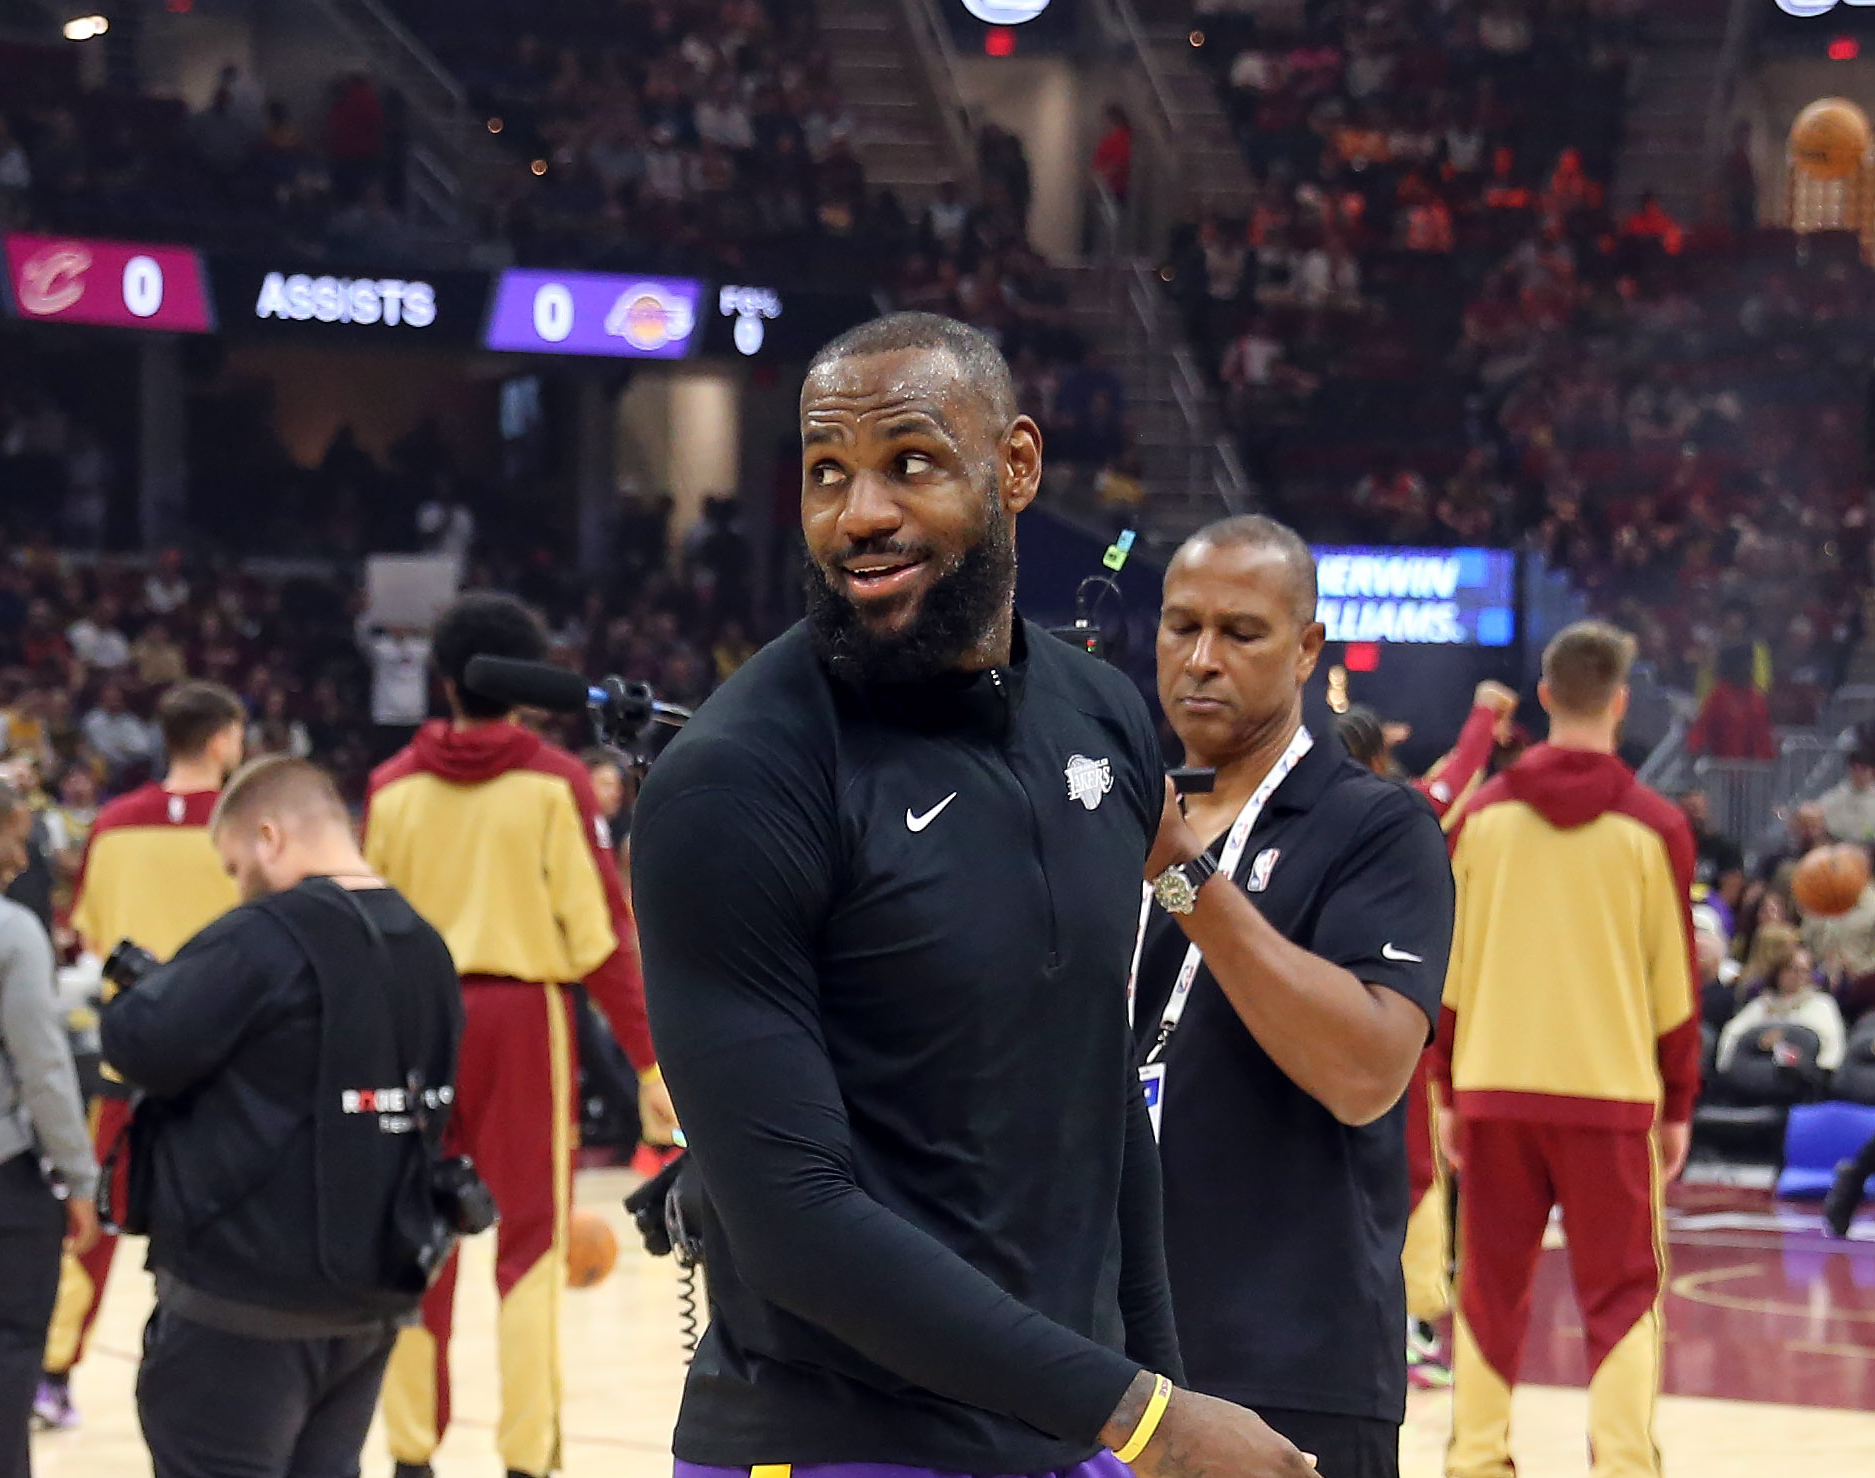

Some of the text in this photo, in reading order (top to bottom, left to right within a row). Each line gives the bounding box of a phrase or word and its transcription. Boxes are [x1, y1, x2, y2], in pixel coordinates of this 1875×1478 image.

[122, 254, 164, 317] 0
[255, 271, 437, 327] ASSISTS
[533, 282, 574, 342] 0
[1064, 766, 1114, 800] LAKERS
